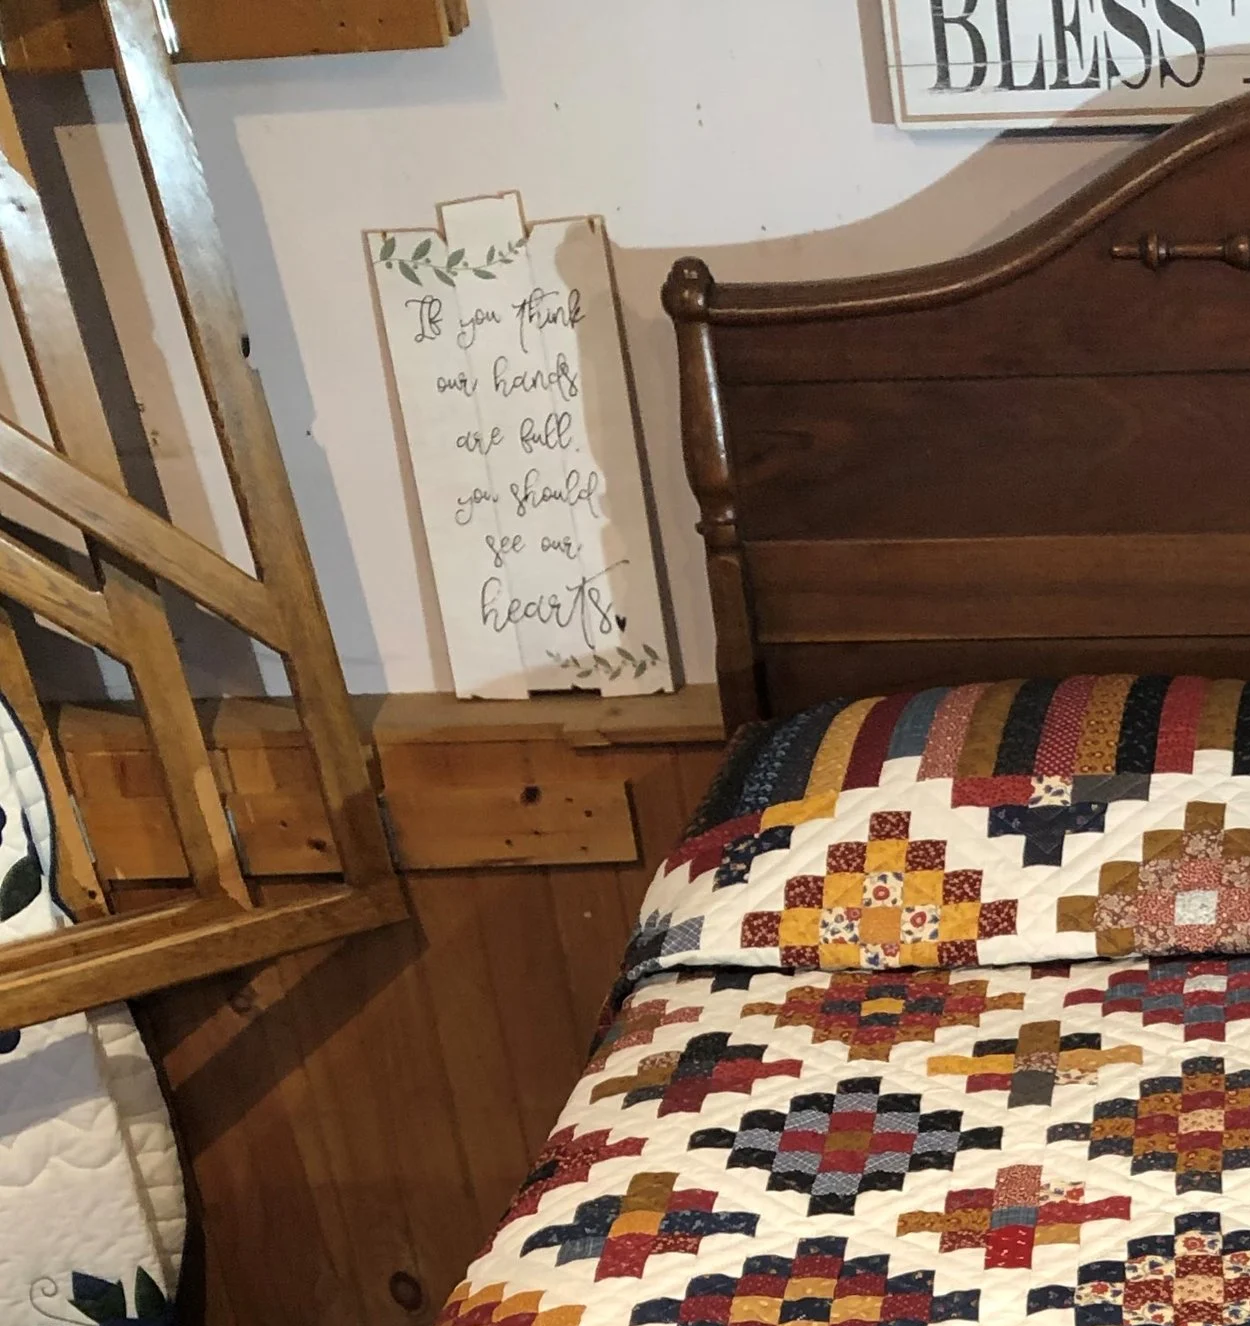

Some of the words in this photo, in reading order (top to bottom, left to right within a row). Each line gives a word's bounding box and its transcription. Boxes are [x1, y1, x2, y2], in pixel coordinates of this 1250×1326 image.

[927, 0, 1206, 92] BLESS
[405, 295, 443, 344] If
[456, 308, 501, 350] you
[436, 371, 479, 398] our
[493, 352, 579, 402] hands
[455, 426, 505, 456] are
[519, 411, 581, 454] full.
[454, 487, 499, 526] you
[509, 467, 600, 519] should
[485, 533, 528, 569] see
[540, 535, 584, 560] our
